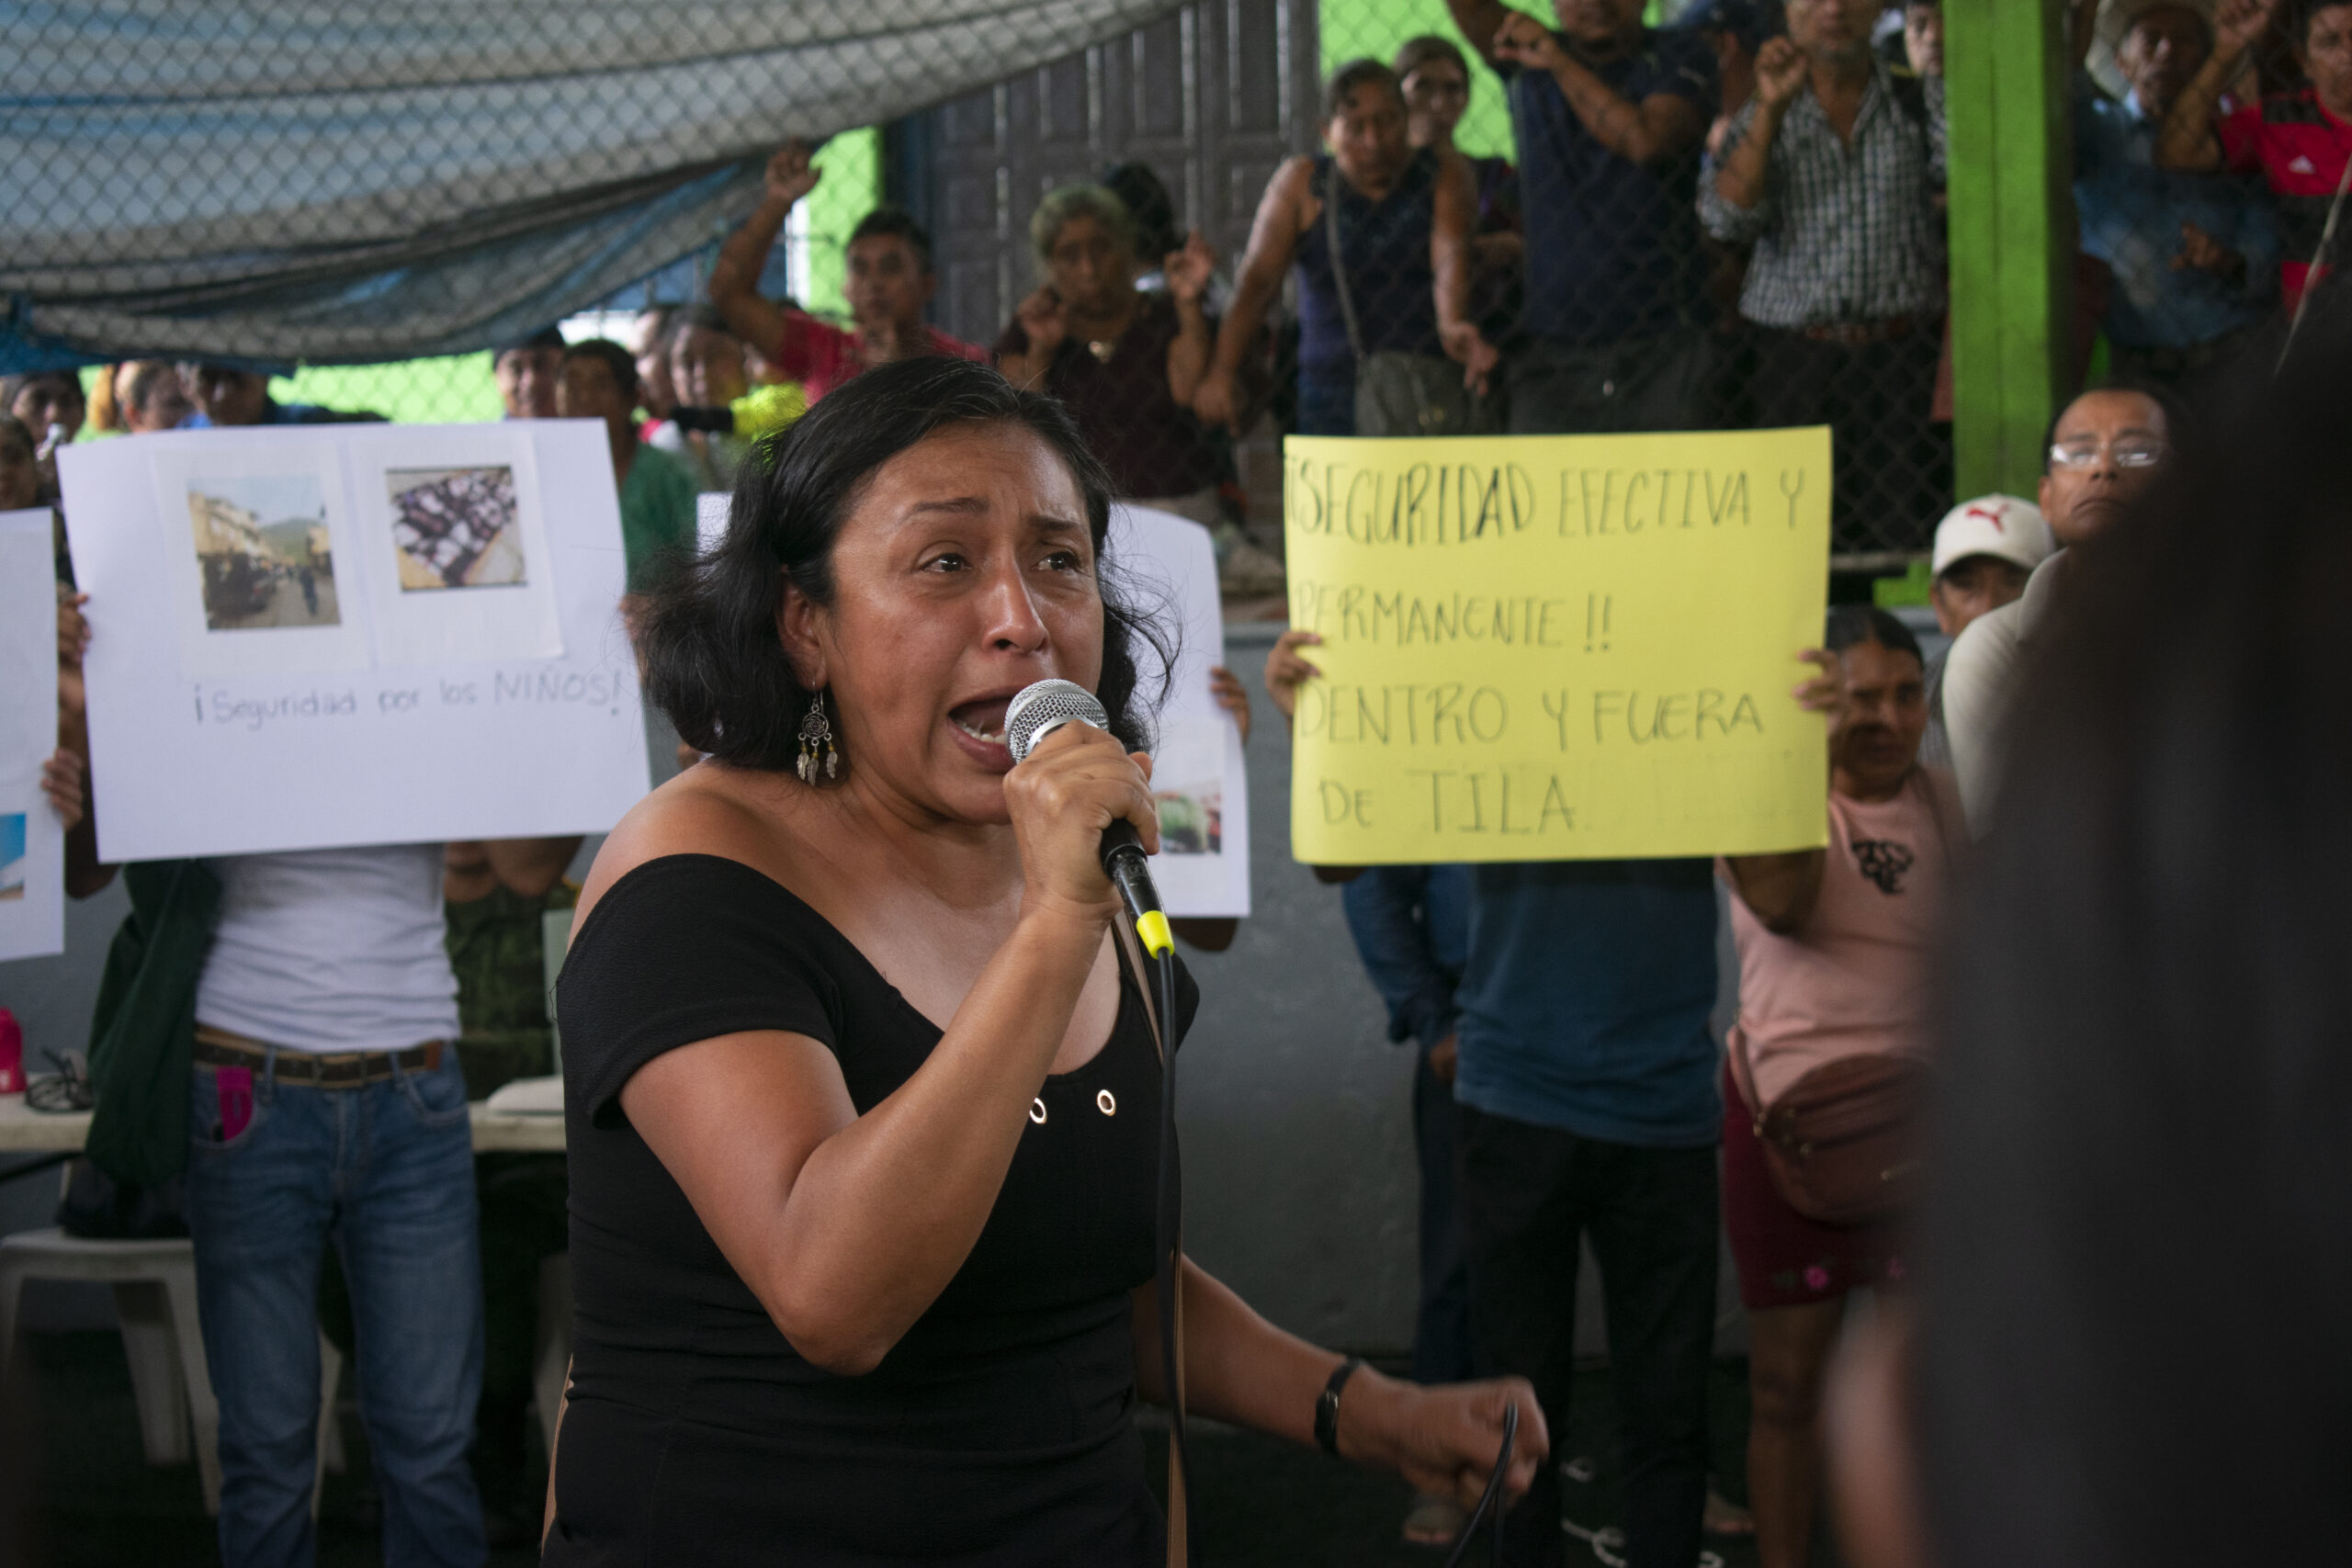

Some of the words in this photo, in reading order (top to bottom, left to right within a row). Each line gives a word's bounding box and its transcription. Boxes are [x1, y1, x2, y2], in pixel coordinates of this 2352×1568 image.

[1557, 467, 1751, 538] EFECTIVA
[1780, 467, 1806, 530] Y
[1295, 579, 1567, 648] PERMANENTE
[194, 683, 358, 731] ¡Seguridad
[378, 687, 422, 716] por
[439, 678, 479, 706] los
[493, 665, 623, 717] NIÑOS!
[1298, 682, 1510, 747] DENTRO
[1542, 689, 1569, 753] Y
[1593, 690, 1765, 746] FUERA
[1317, 778, 1374, 828] DE
